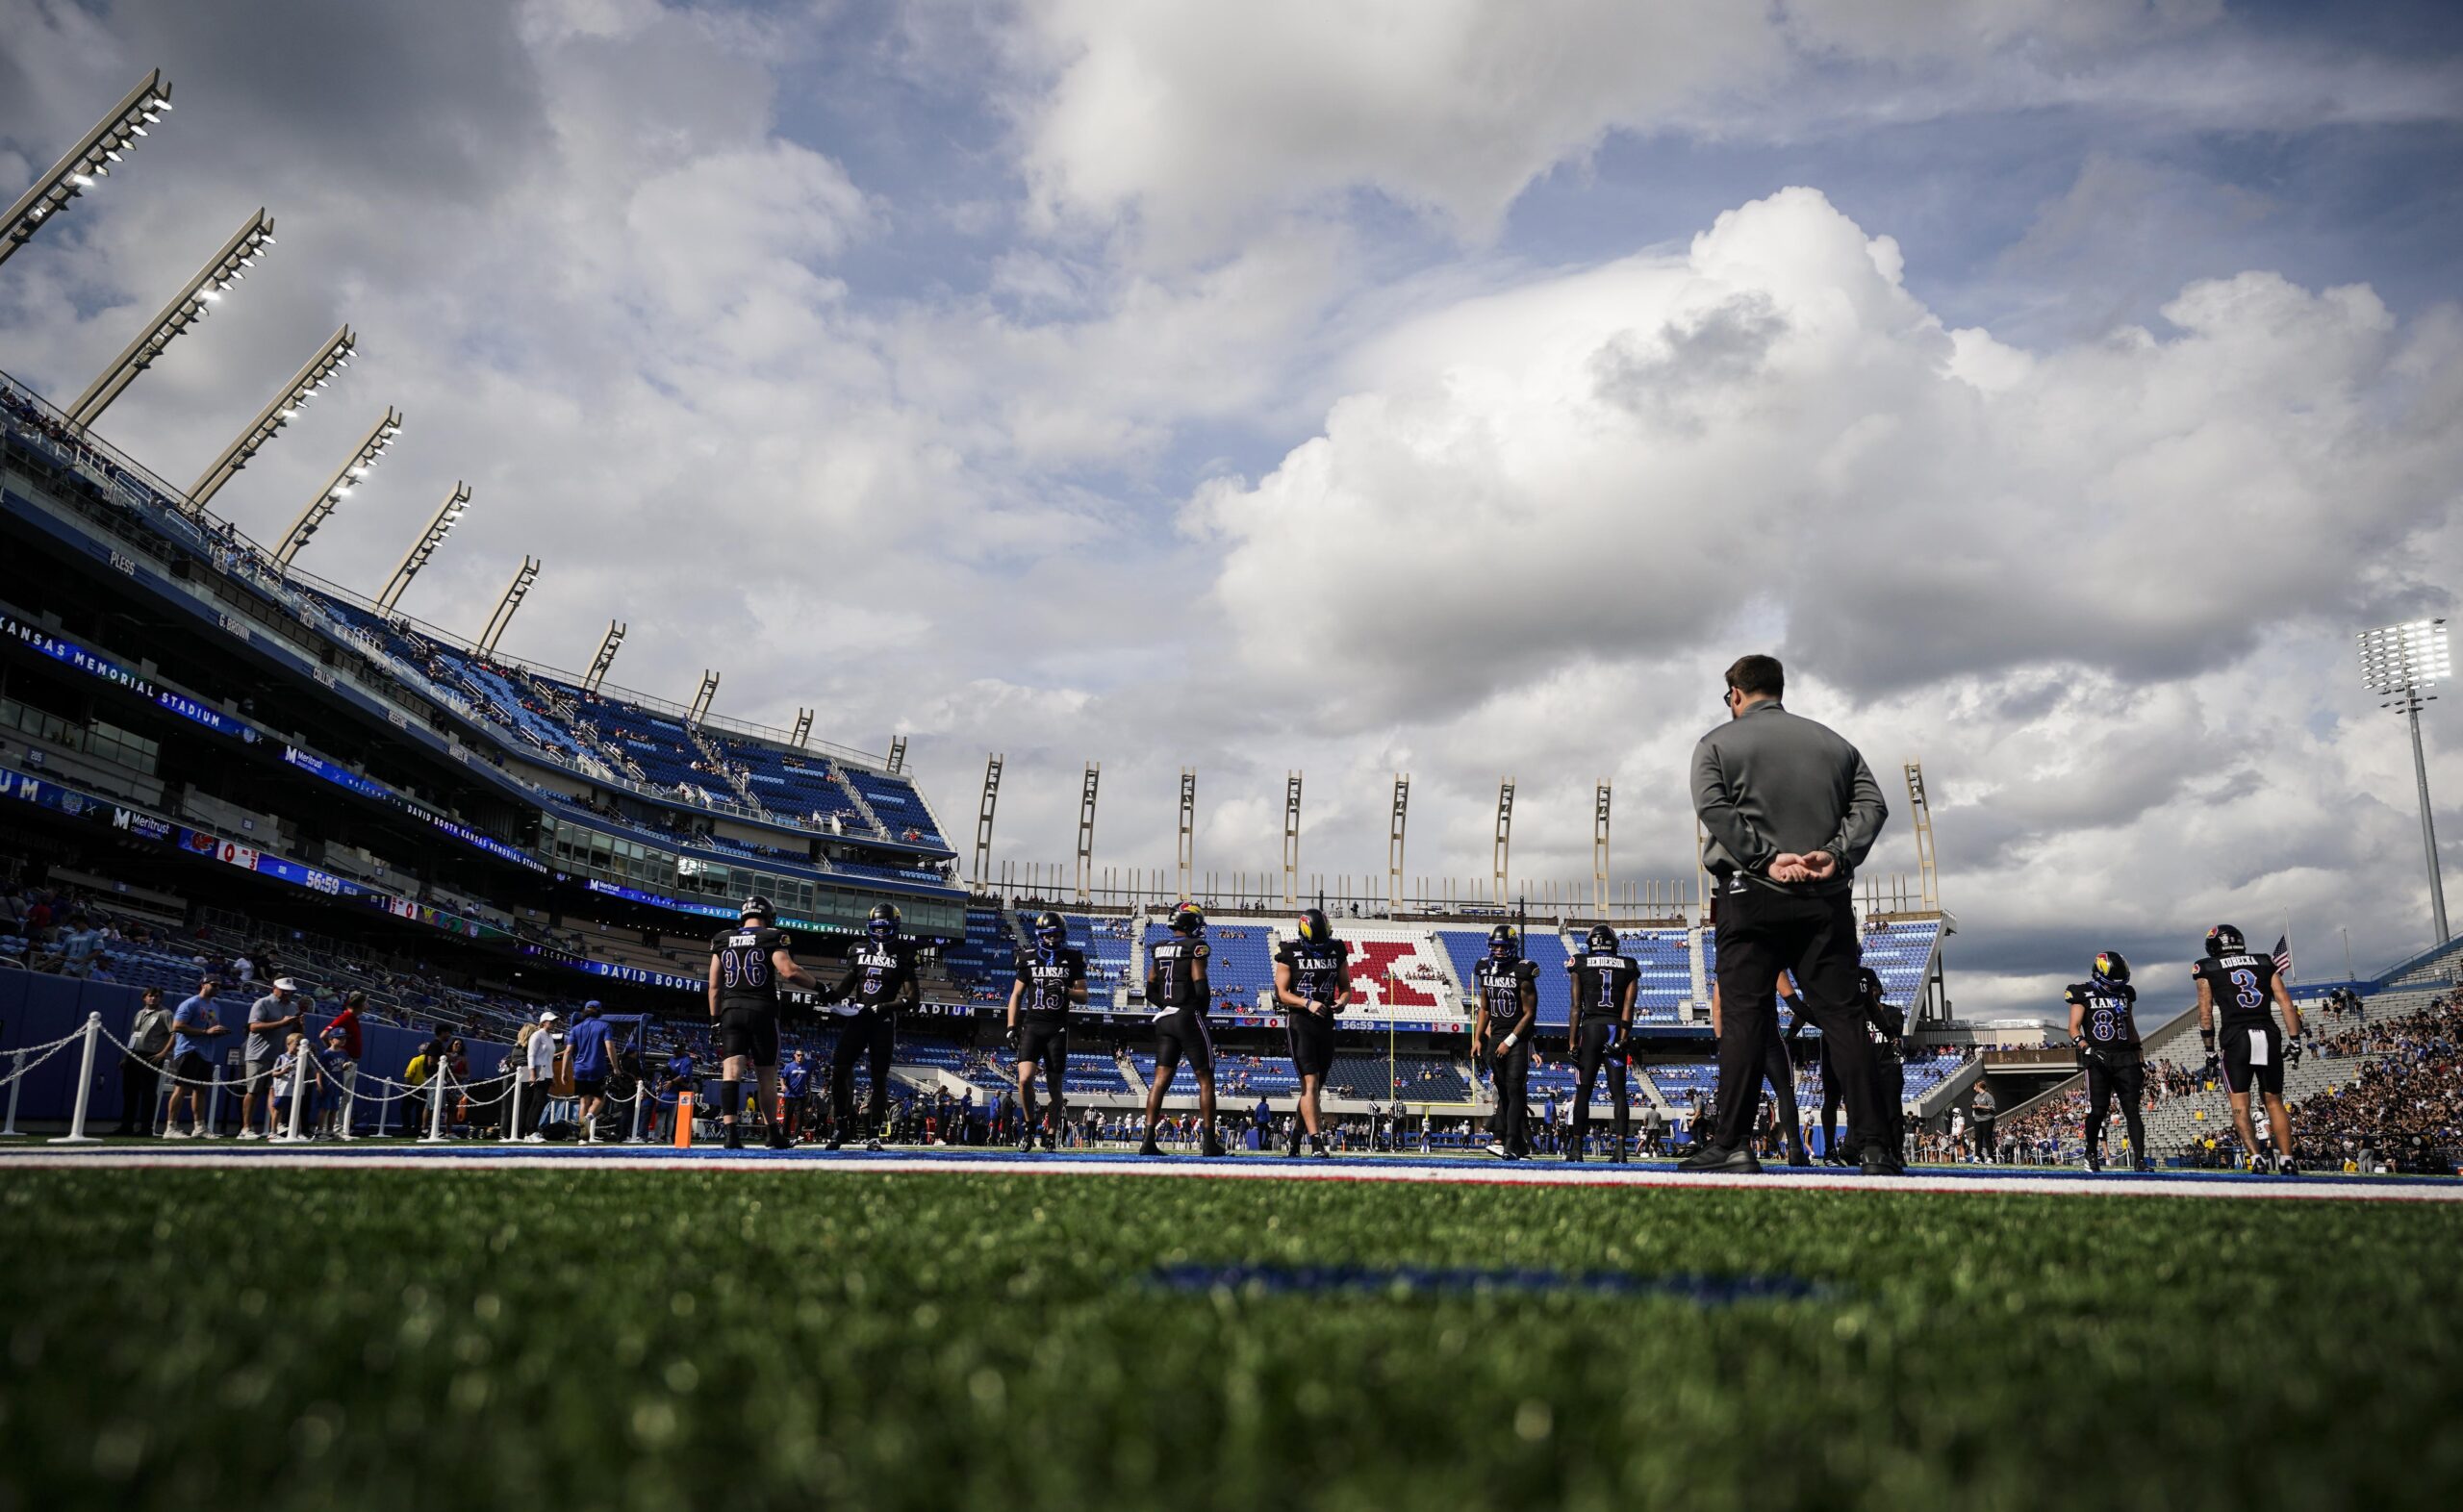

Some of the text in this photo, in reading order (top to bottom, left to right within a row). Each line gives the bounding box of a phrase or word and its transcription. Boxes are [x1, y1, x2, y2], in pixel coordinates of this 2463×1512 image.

[110, 551, 136, 576] PLESS
[218, 614, 250, 642] G. BROWN
[74, 652, 154, 697] MEMORIAL
[162, 692, 219, 726] STADIUM
[313, 668, 337, 690] COLLINS
[30, 750, 42, 763] 205
[297, 750, 323, 769] Meritrust
[131, 812, 170, 835] Meritrust
[407, 804, 547, 874] DAVID BOOTH KANSAS MEMORIAL STADIUM
[224, 843, 235, 863] 0
[305, 869, 339, 895] 56:59
[406, 903, 413, 919] 0
[702, 907, 732, 918] DAVID
[775, 919, 867, 936] ANSAS MEMORIAL
[728, 934, 756, 947] PETRUS
[529, 945, 589, 969] WELCOME TO
[721, 947, 768, 989] 96
[857, 954, 898, 970] KANSAS
[1297, 958, 1337, 970] KANSAS
[1587, 956, 1626, 969] HENDERSON
[2219, 955, 2259, 969] KUBECKA
[600, 964, 702, 992] DAVID BOOTH
[863, 967, 883, 995] 5
[1030, 966, 1070, 978] KANSAS
[1159, 960, 1174, 999] 7
[1483, 975, 1517, 989] KANSAS
[1296, 971, 1337, 1001] 44
[1597, 969, 1614, 1008] 1
[2230, 969, 2264, 1008] 3
[918, 1003, 976, 1017] ADIUM
[1485, 986, 1517, 1019] 10
[1342, 1021, 1374, 1030] 56:59
